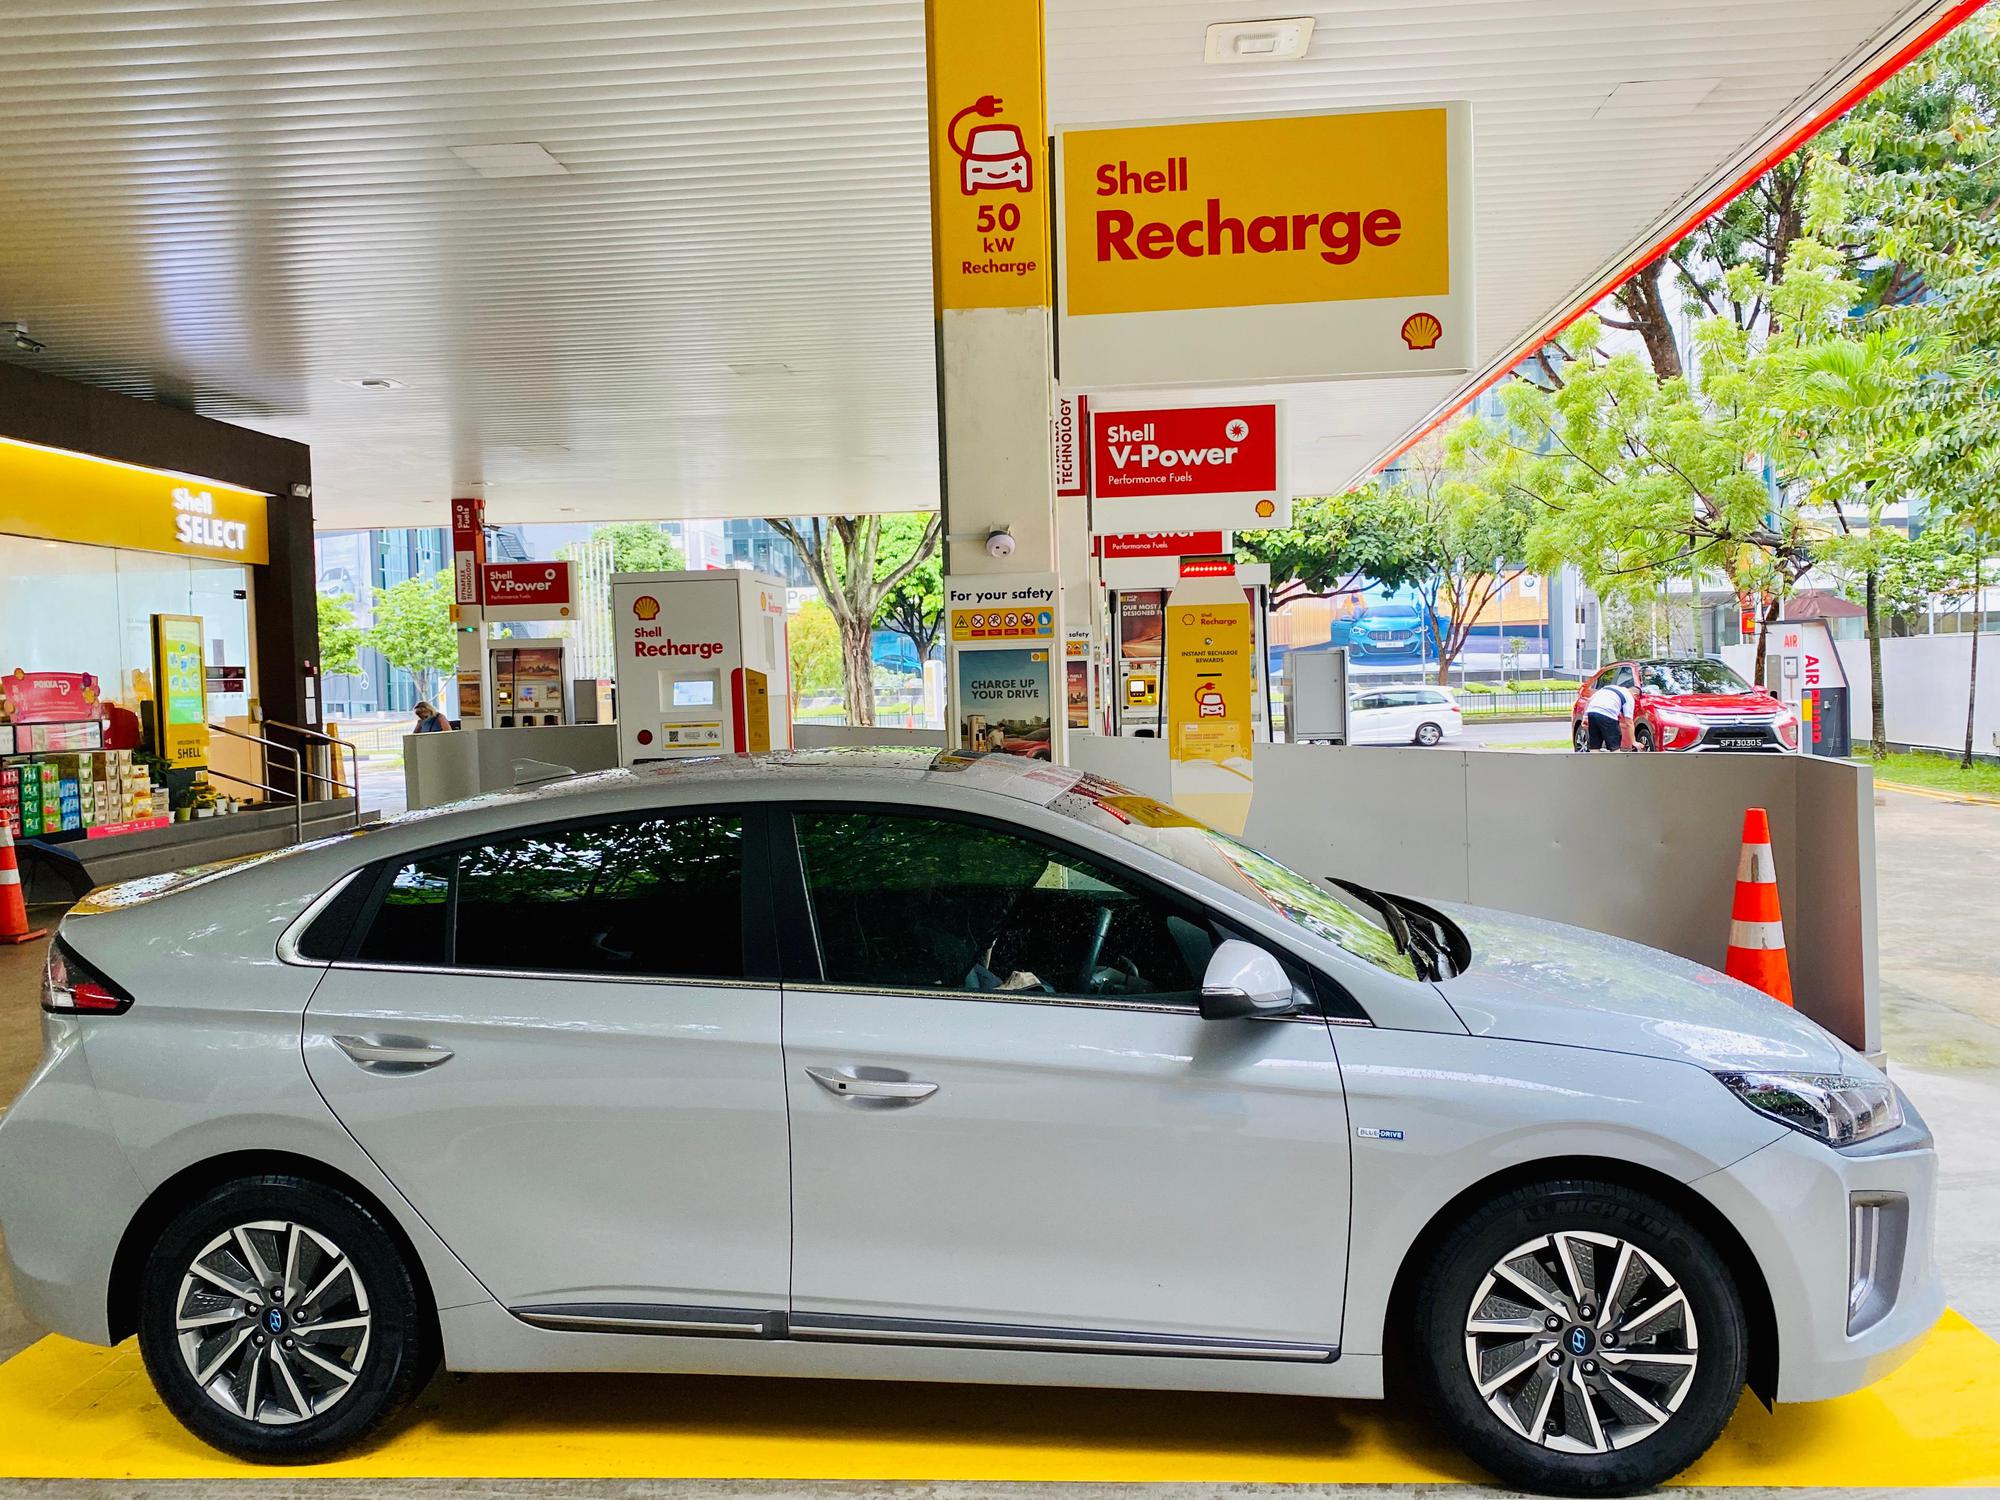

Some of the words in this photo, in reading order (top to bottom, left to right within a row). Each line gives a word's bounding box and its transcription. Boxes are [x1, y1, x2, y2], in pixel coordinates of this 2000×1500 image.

[1096, 157, 1188, 196] Shell
[976, 203, 1021, 233] 50
[1096, 198, 1402, 266] Recharge
[983, 238, 1015, 254] kW
[962, 258, 1037, 276] Recharge
[1060, 398, 1073, 485] TECHNOLOGY
[1107, 423, 1155, 444] Shell
[1108, 445, 1238, 469] V-Power
[1108, 475, 1166, 485] Performance
[1169, 473, 1192, 483] Fuels
[172, 487, 212, 514] Shell
[176, 513, 247, 550] SELECT
[1112, 542, 1151, 551] Performance
[1152, 541, 1168, 549] Fuels
[489, 570, 513, 580] Shell
[490, 581, 551, 592] V-Power
[950, 590, 971, 602] For
[976, 590, 1008, 604] your
[1012, 587, 1054, 601] safety
[1200, 618, 1238, 627] Recharge
[634, 626, 662, 638] Shell
[1068, 631, 1090, 639] safety
[634, 639, 723, 659] Recharge
[1783, 634, 1798, 649] AIR
[1804, 654, 1820, 686] AIR
[971, 680, 1016, 689] CHARGE
[1020, 679, 1035, 688] UP
[971, 689, 1003, 700] YOUR
[1007, 689, 1039, 699] DRIVE
[177, 747, 201, 759] SHELL
